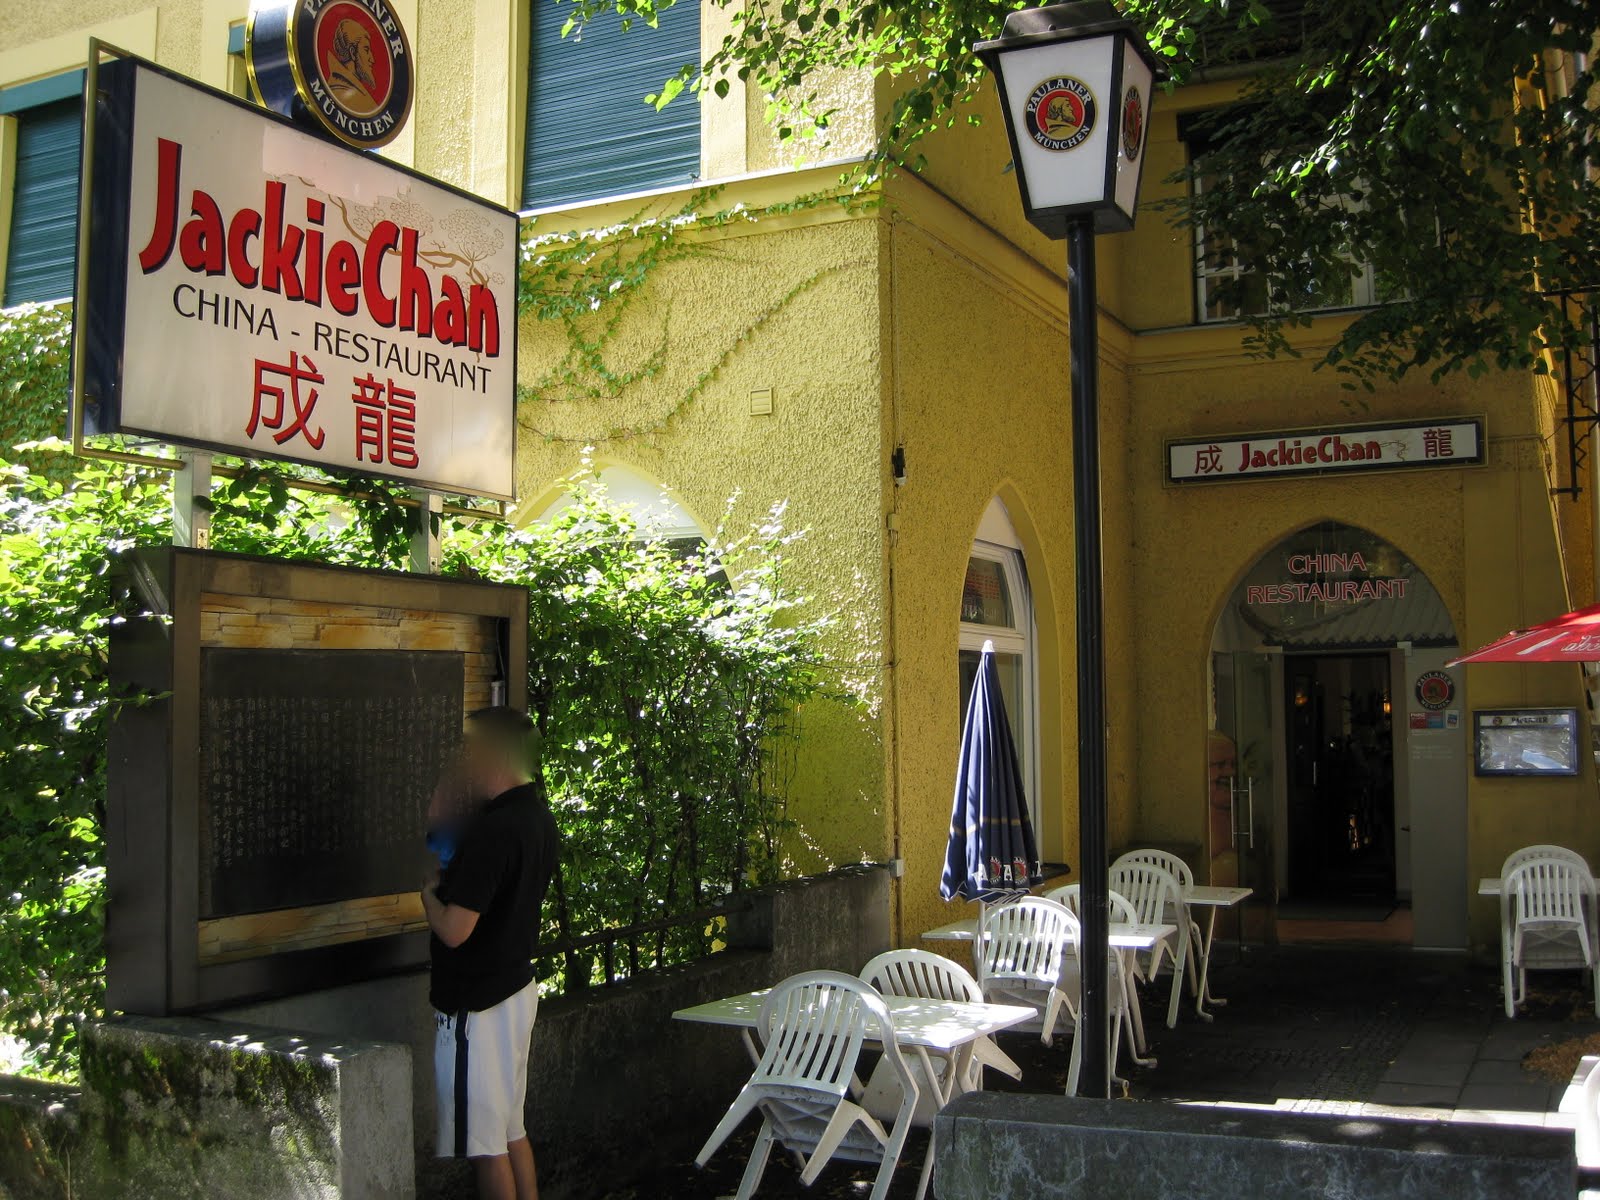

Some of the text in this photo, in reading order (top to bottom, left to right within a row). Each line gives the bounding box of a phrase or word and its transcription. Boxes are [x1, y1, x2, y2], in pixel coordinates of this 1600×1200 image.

[304, 0, 404, 59] PNER
[310, 78, 395, 137] MÜNCHEN
[1027, 78, 1092, 113] PAULANER
[139, 137, 500, 358] JackieChan
[173, 283, 279, 341] CHINA
[314, 322, 492, 394] RESTAURANT
[1194, 428, 1454, 475] 成 JackieChan 龍
[1288, 551, 1367, 575] CHINA
[1247, 578, 1410, 605] RESTAURANT
